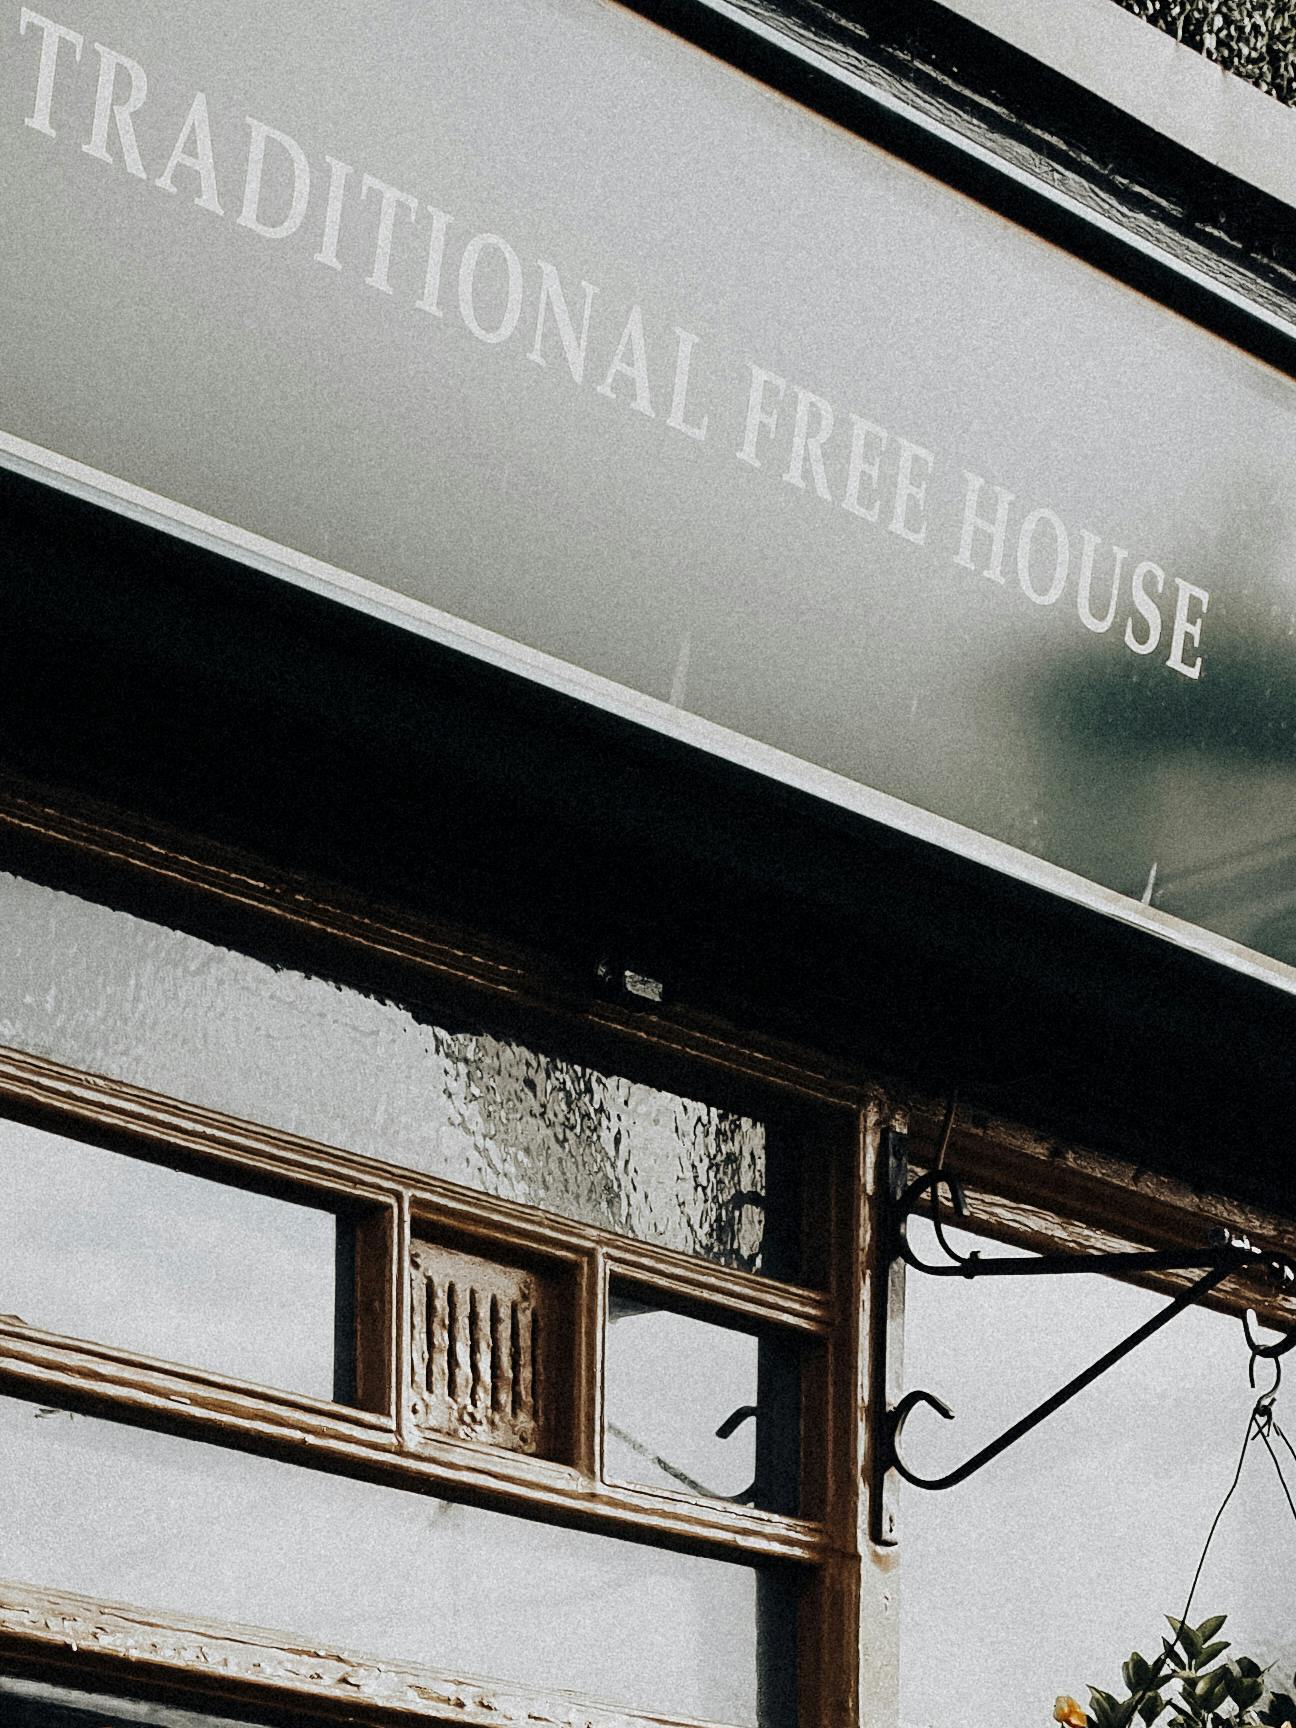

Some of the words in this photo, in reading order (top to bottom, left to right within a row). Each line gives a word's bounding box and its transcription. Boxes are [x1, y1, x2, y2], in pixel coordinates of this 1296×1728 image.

[19, 6, 708, 442] TRADITIONAL
[737, 363, 934, 545] FREE
[956, 472, 1210, 680] HOUSE
